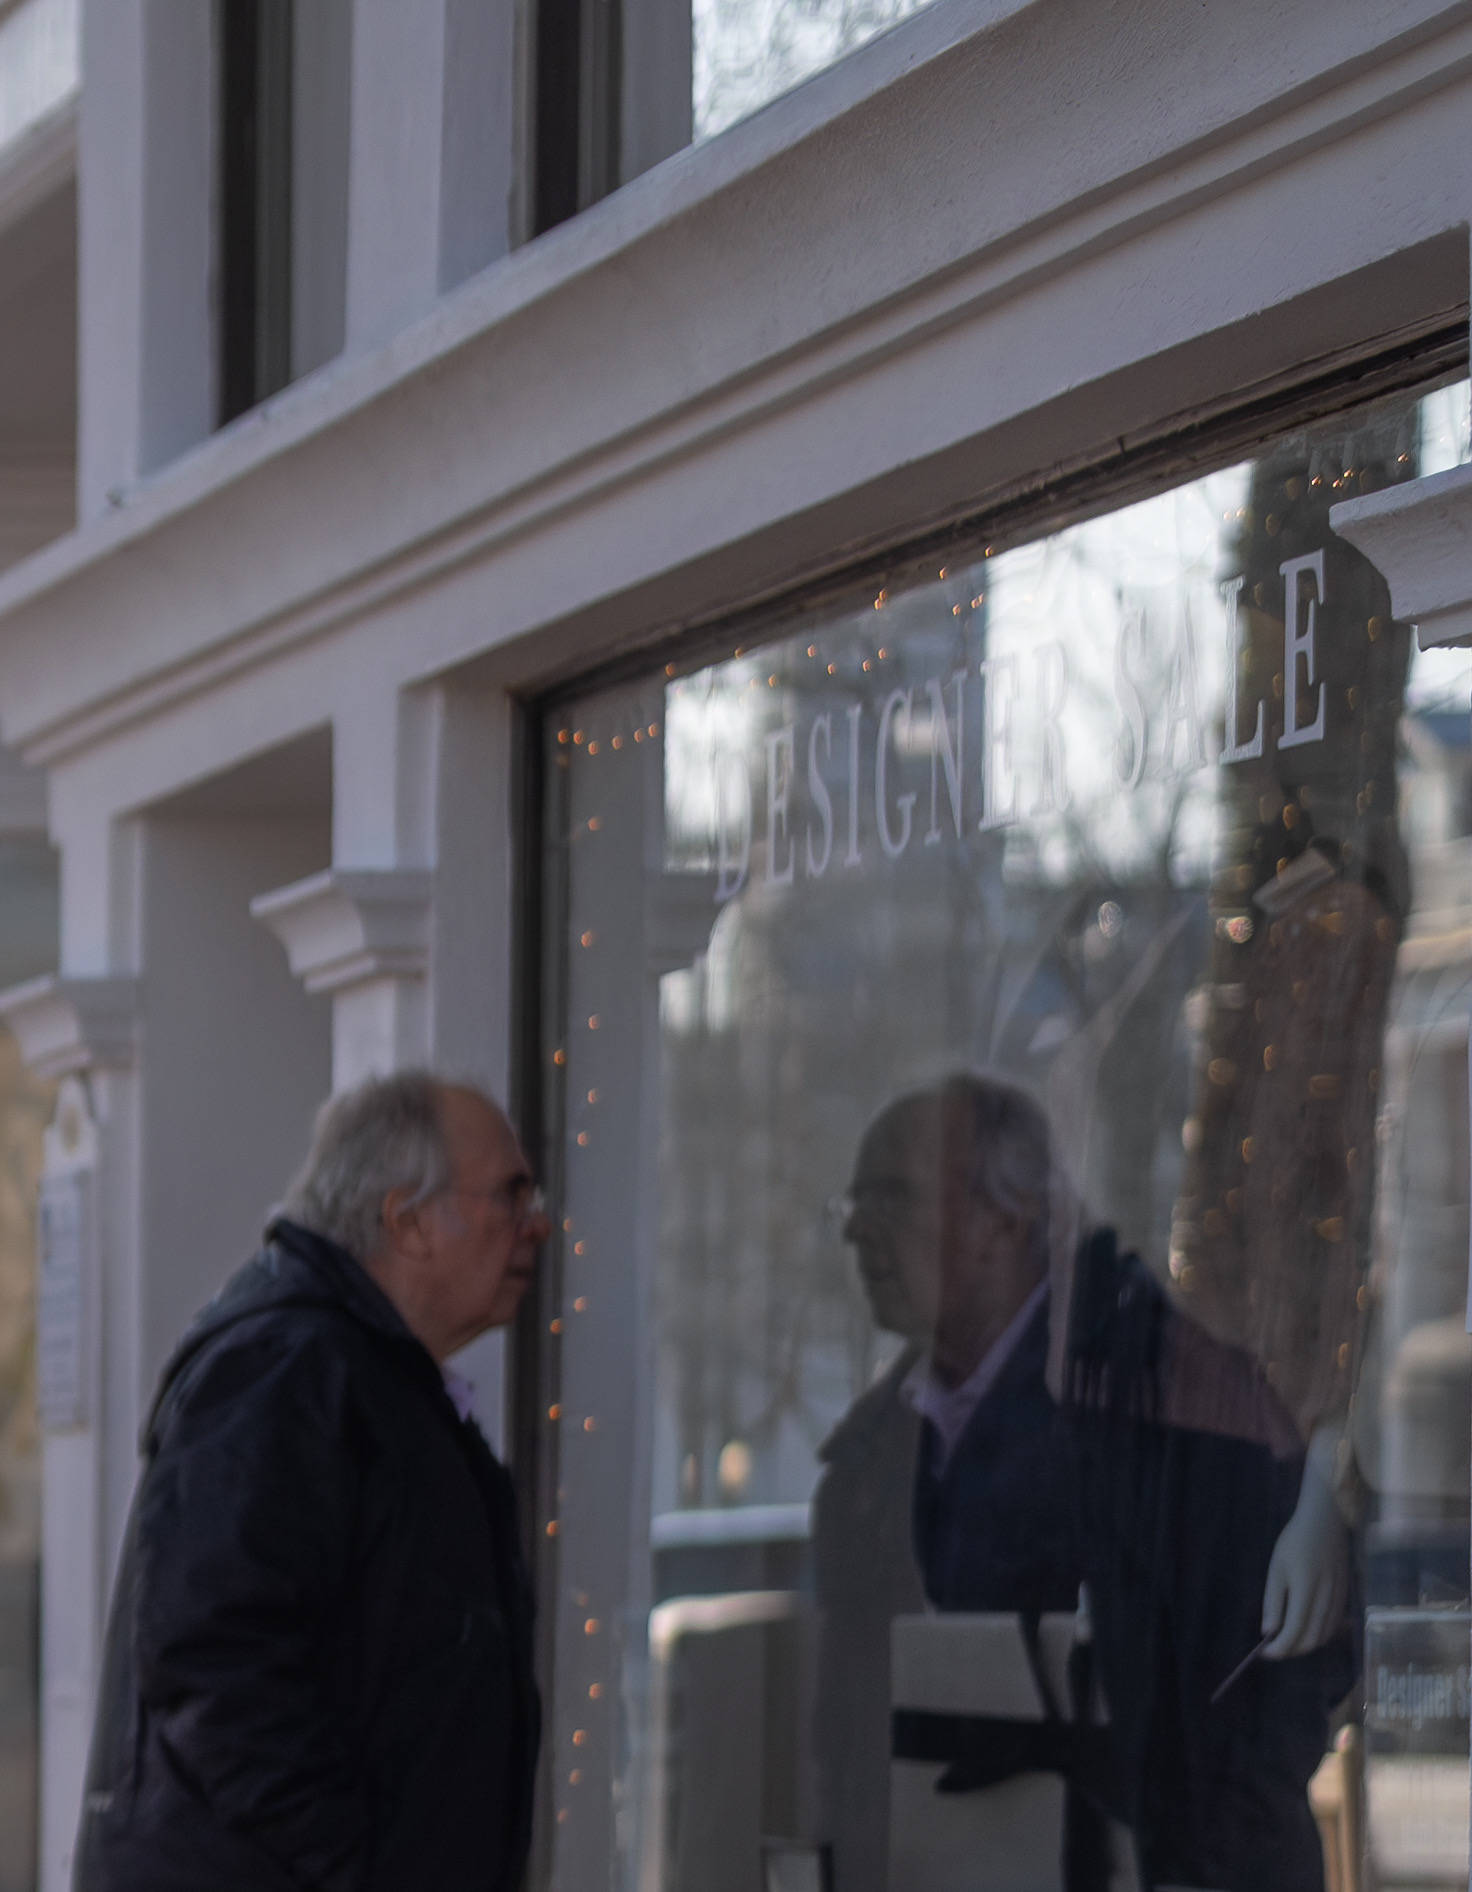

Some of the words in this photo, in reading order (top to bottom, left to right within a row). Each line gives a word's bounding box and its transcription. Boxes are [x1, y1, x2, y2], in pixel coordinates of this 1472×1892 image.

[710, 638, 1073, 904] DESIGNER
[1113, 547, 1326, 793] SALE
[1376, 1661, 1453, 1732] Designer
